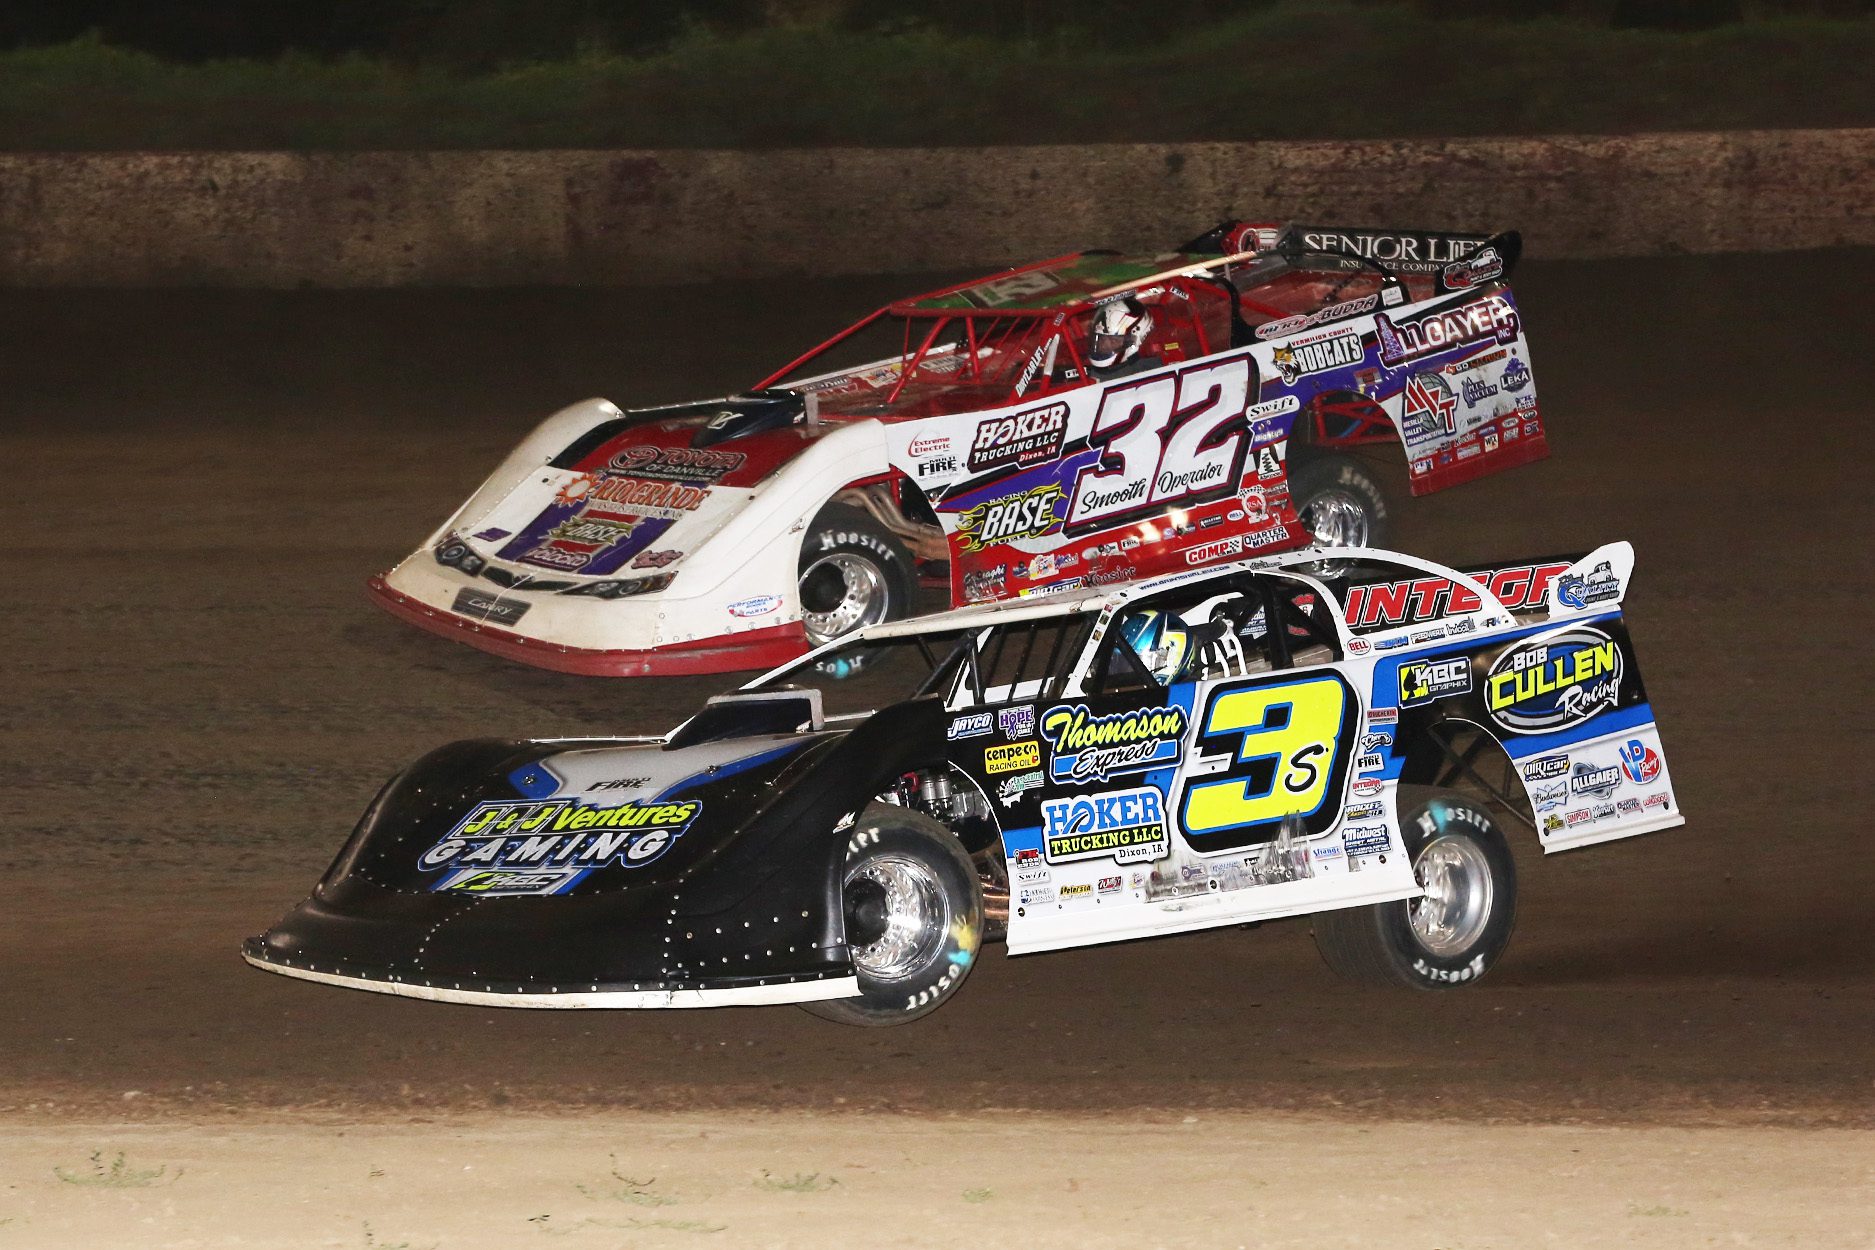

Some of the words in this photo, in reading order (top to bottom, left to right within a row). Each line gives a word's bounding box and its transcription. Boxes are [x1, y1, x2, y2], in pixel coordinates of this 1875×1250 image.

[1428, 238, 1485, 262] LIF
[1402, 262, 1443, 272] COMPA
[1291, 333, 1327, 347] VERMILION
[1328, 327, 1354, 338] COUNTY
[1497, 327, 1511, 339] INC
[1295, 334, 1362, 373] BOBCATS
[1468, 382, 1485, 393] PLUS
[1501, 370, 1529, 387] LEKA
[1250, 397, 1295, 417] Swift
[974, 403, 1066, 449] HOKER
[914, 437, 950, 448] Extreme
[914, 443, 951, 454] Electric
[974, 441, 1033, 465] TRUCKING
[1035, 432, 1059, 448] LLC
[1047, 448, 1057, 456] IA
[1070, 358, 1250, 526] 32
[659, 448, 740, 469] TOYOTA
[646, 464, 662, 472] OF
[662, 465, 723, 477] DANVILLE
[989, 490, 1028, 504] RACING
[1080, 477, 1148, 516] Smooth
[1157, 461, 1225, 496] Operator
[980, 490, 1058, 541] BASE
[1244, 526, 1285, 545] QUARTER
[1252, 532, 1288, 548] MASTER
[1188, 540, 1230, 562] COMP
[1349, 640, 1369, 651] BELL
[1513, 646, 1548, 671] BOB
[1489, 640, 1614, 711] CULLEN
[1555, 677, 1620, 720] Racing
[948, 713, 991, 738] JAYCO
[1000, 710, 1033, 727] HOPE
[1046, 708, 1181, 753] Thomason
[989, 760, 1018, 772] RACING
[1020, 758, 1032, 767] OIL
[1072, 741, 1158, 776] Express
[1357, 757, 1381, 768] FIRE
[1353, 779, 1381, 790] INTEGRA
[1571, 767, 1620, 793] ALLGAIER
[552, 803, 697, 831] Ventures
[1046, 792, 1162, 837] HOKER
[1416, 807, 1491, 838] Hosier
[1567, 809, 1590, 824] SIMPSON
[1051, 830, 1129, 855] TRUCKING
[1133, 826, 1162, 842] LLC
[1343, 824, 1386, 841] Midwest
[1152, 843, 1164, 853] IA
[1018, 871, 1047, 880] Swift
